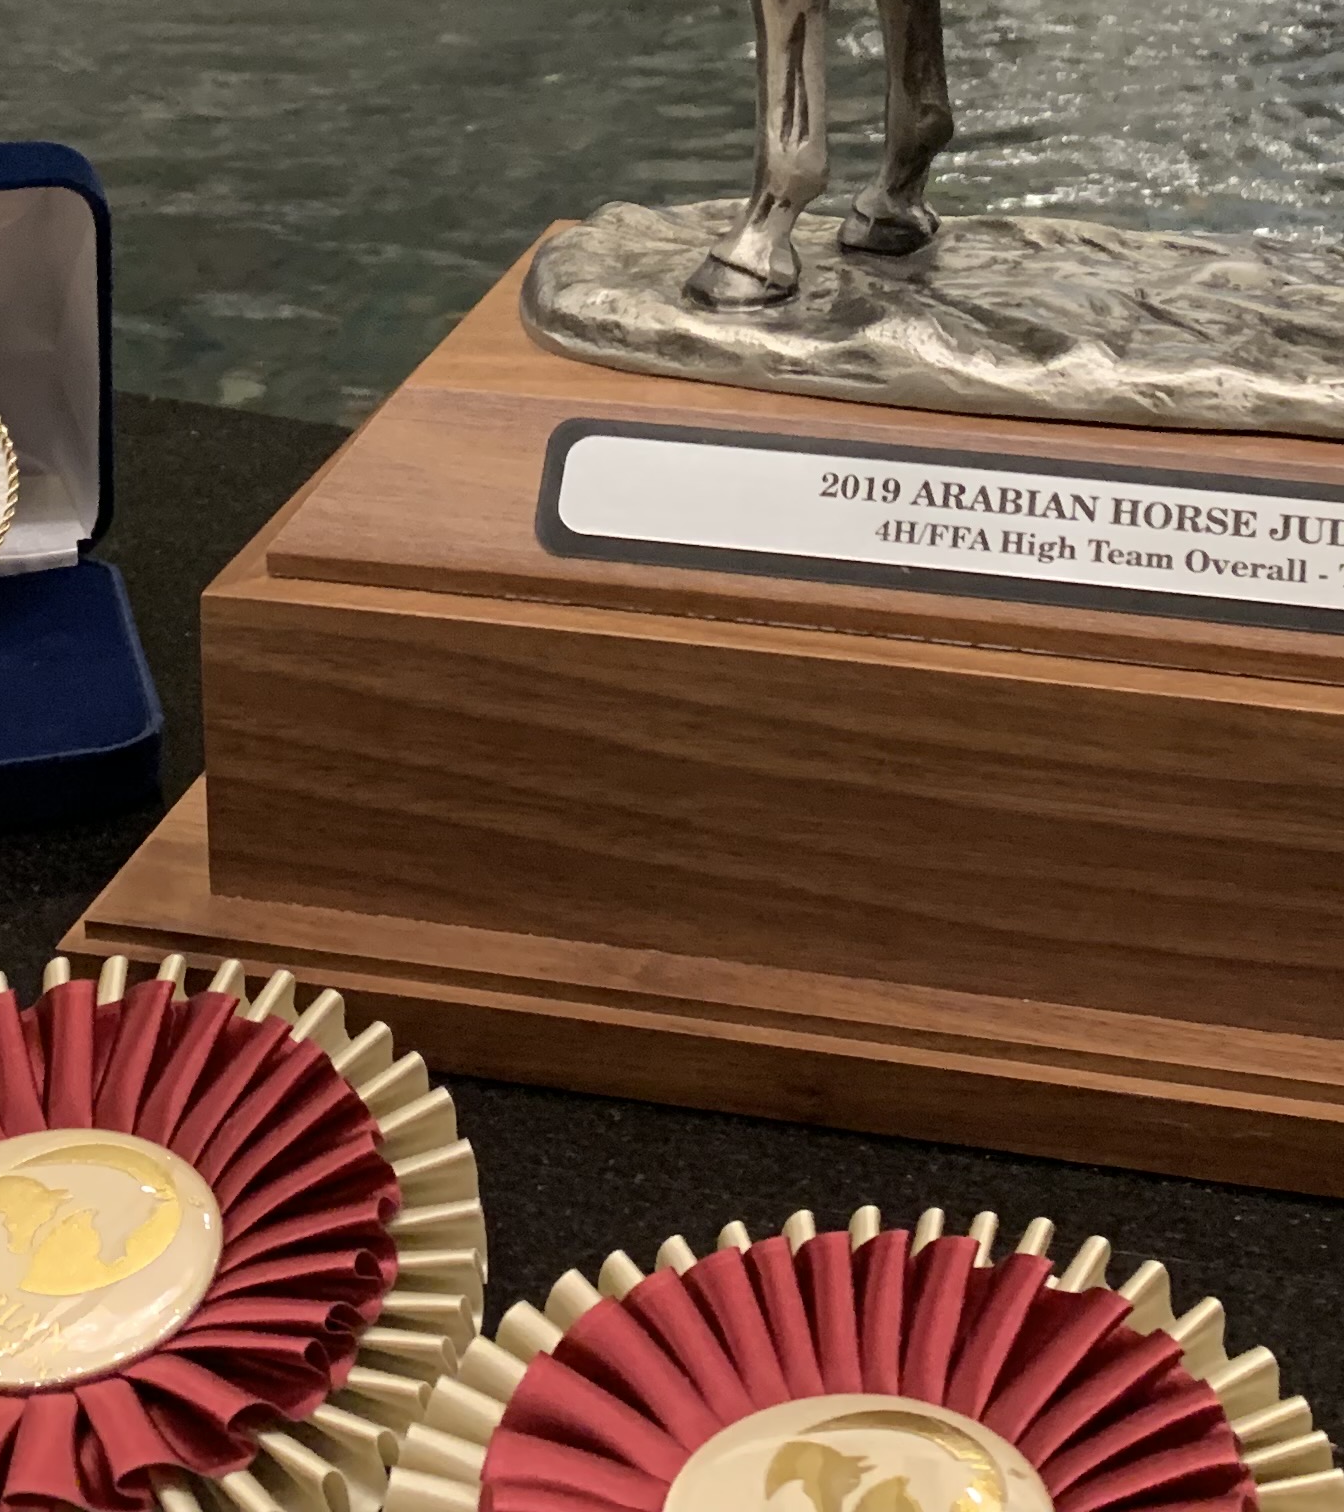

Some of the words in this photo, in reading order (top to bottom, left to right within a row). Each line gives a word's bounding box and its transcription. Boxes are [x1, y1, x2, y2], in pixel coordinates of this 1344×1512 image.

[819, 472, 901, 503] 2019
[909, 479, 1101, 523] ARABIAN
[1109, 497, 1258, 538] HORSE
[874, 519, 992, 553] 4H/FFA
[999, 530, 1078, 564] High
[1087, 538, 1175, 571] Team
[1184, 548, 1309, 584] Overall
